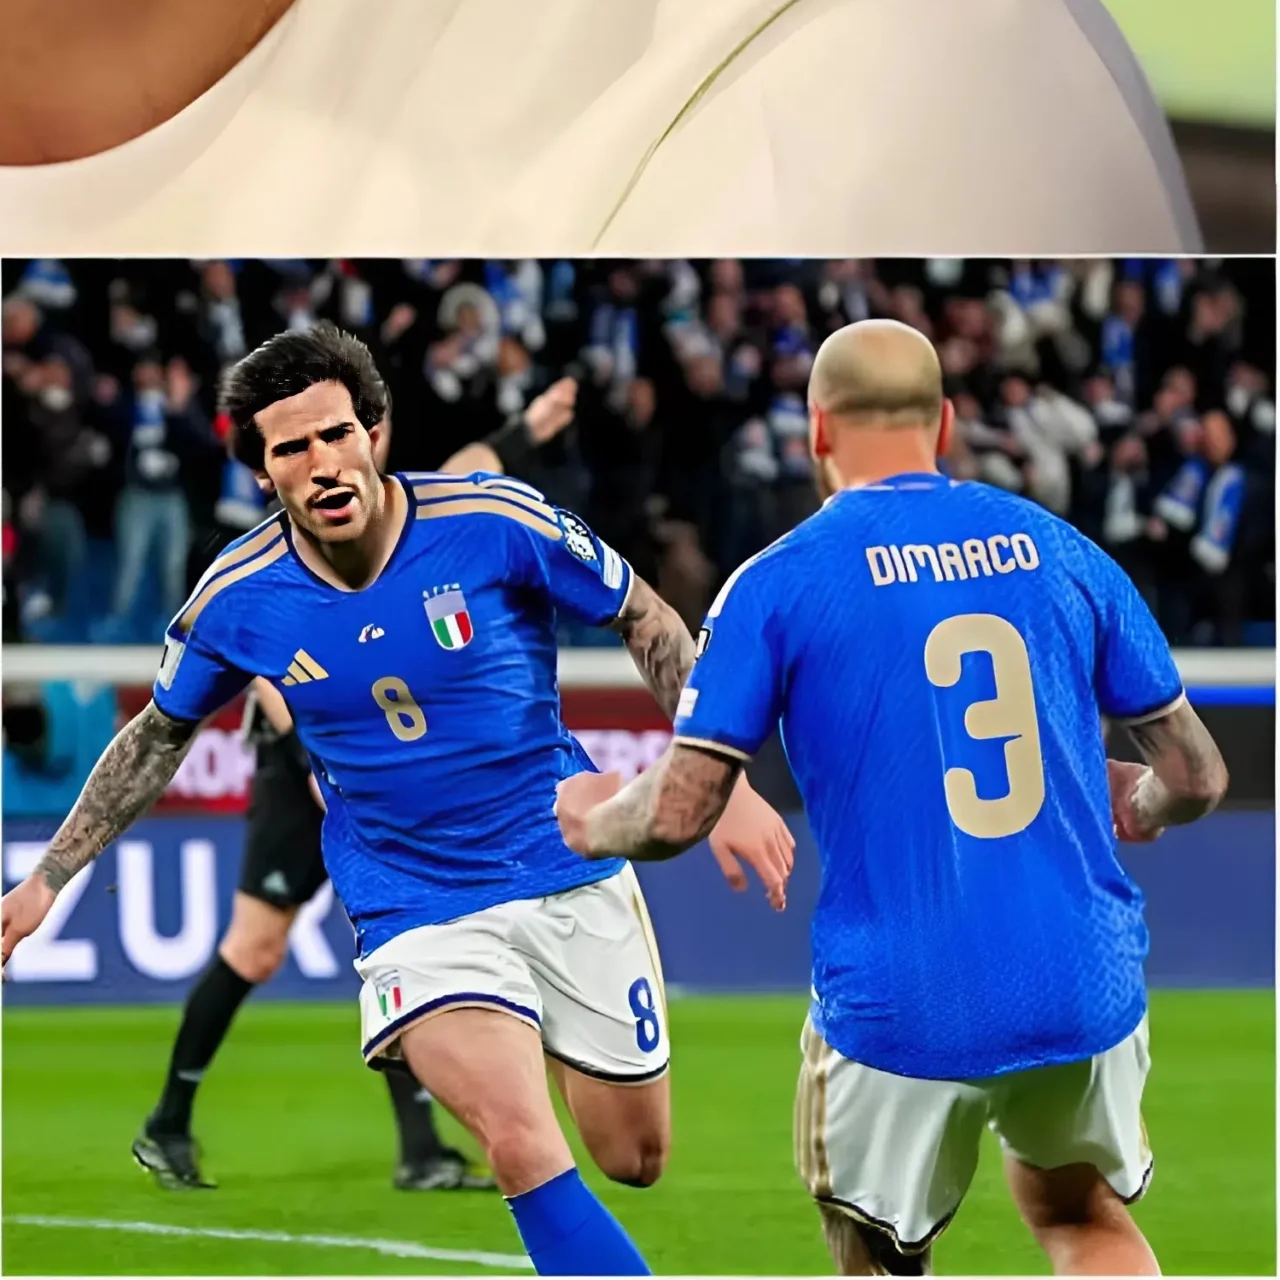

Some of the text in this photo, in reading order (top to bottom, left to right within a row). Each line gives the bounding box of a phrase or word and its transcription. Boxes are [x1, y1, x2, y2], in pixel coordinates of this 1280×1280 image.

[866, 533, 1040, 586] DIMARCO
[372, 676, 427, 742] 8
[924, 613, 1045, 839] 3
[628, 976, 659, 1053] 8
